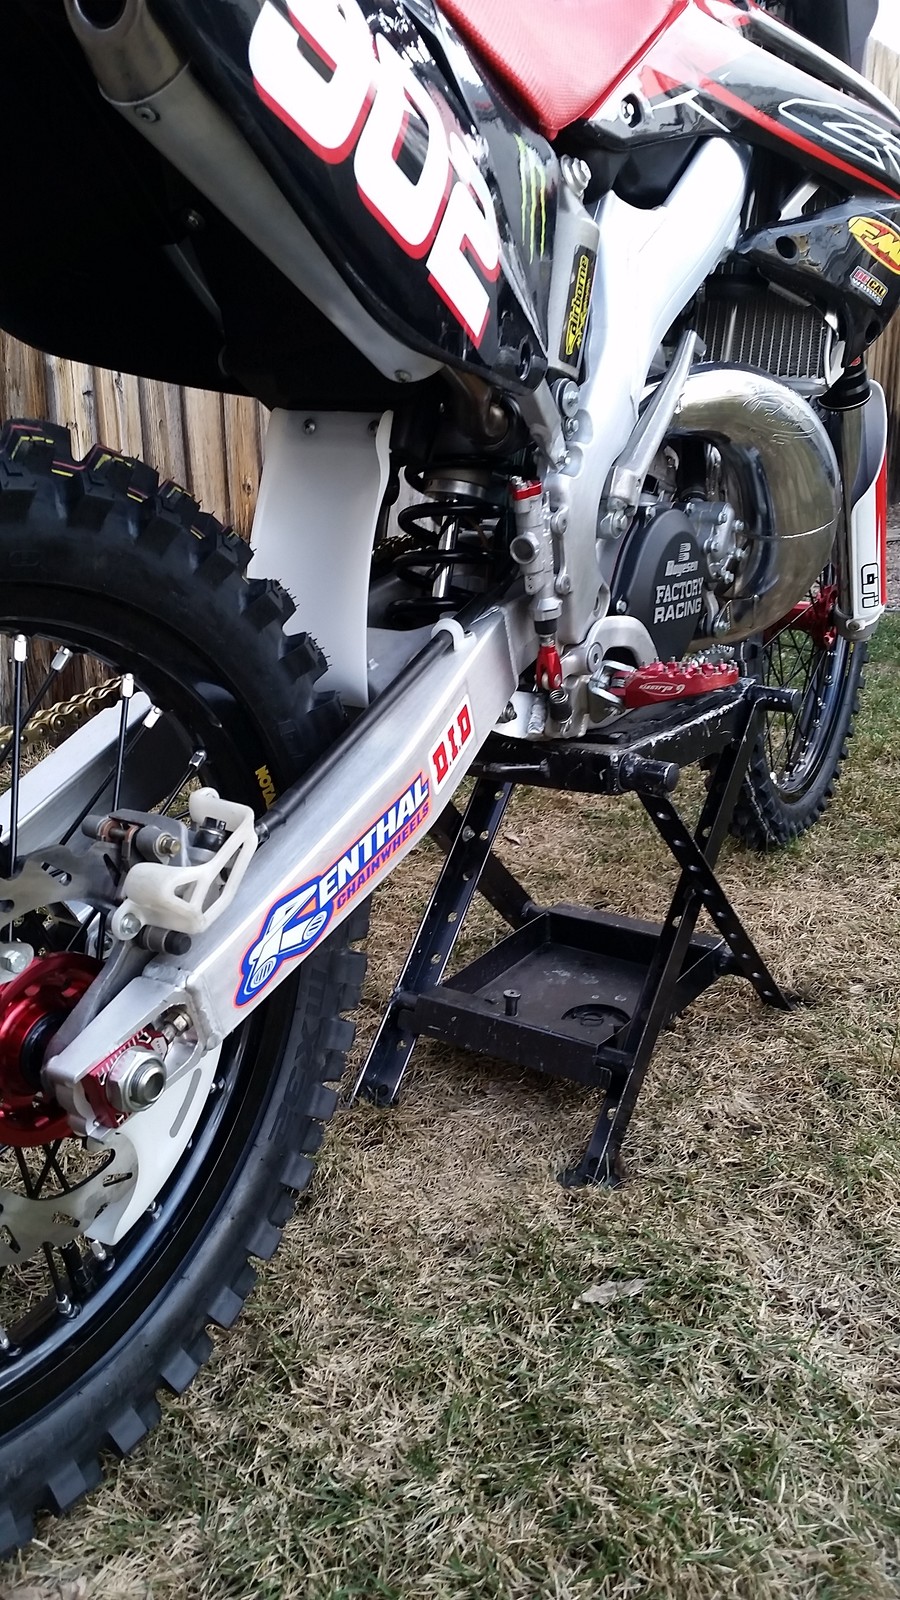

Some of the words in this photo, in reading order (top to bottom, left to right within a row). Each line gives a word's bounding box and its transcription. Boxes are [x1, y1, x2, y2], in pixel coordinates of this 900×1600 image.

[655, 577, 704, 604] FACTORY
[653, 597, 702, 624] RACING
[336, 800, 430, 910] CHAINWHEELS
